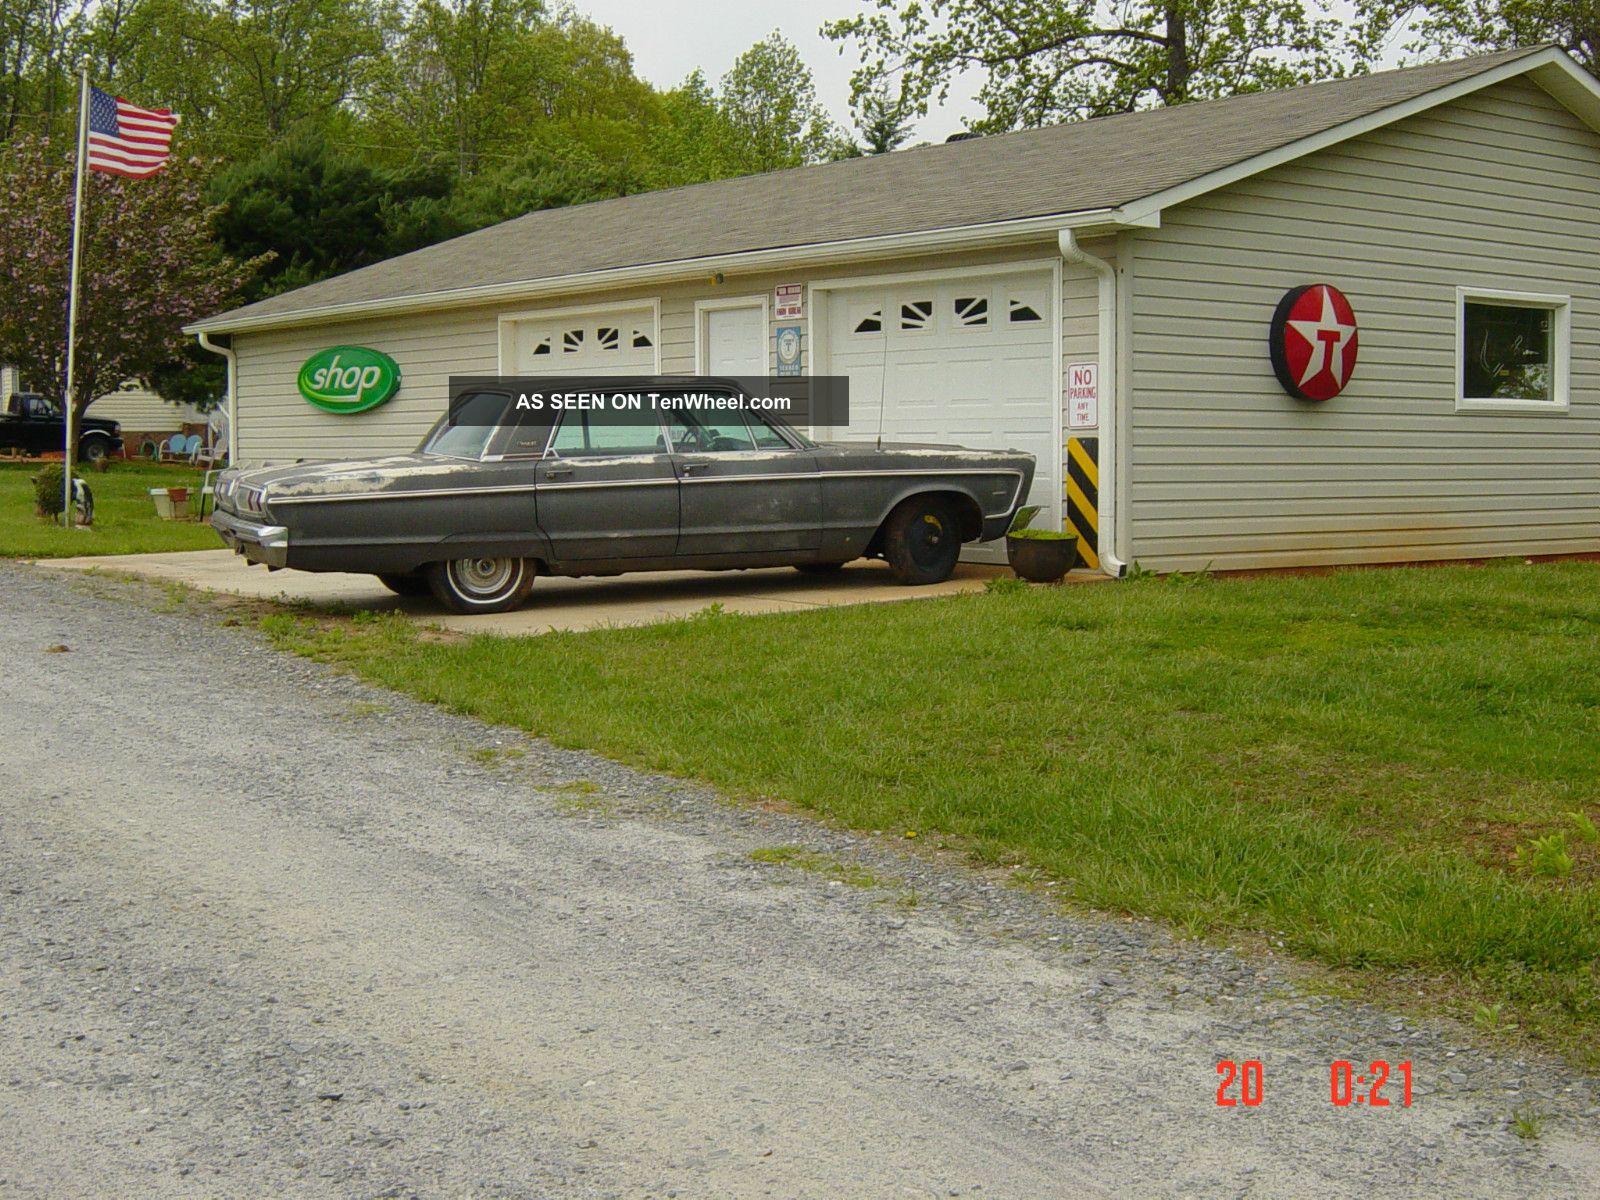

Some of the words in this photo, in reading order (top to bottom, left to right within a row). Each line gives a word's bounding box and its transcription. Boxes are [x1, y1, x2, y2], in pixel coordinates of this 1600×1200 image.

[311, 355, 381, 402] shop
[1074, 369, 1092, 385] NO
[1069, 387, 1097, 399] PARKING
[1077, 402, 1089, 410] ANY
[1076, 413, 1089, 421] TIME
